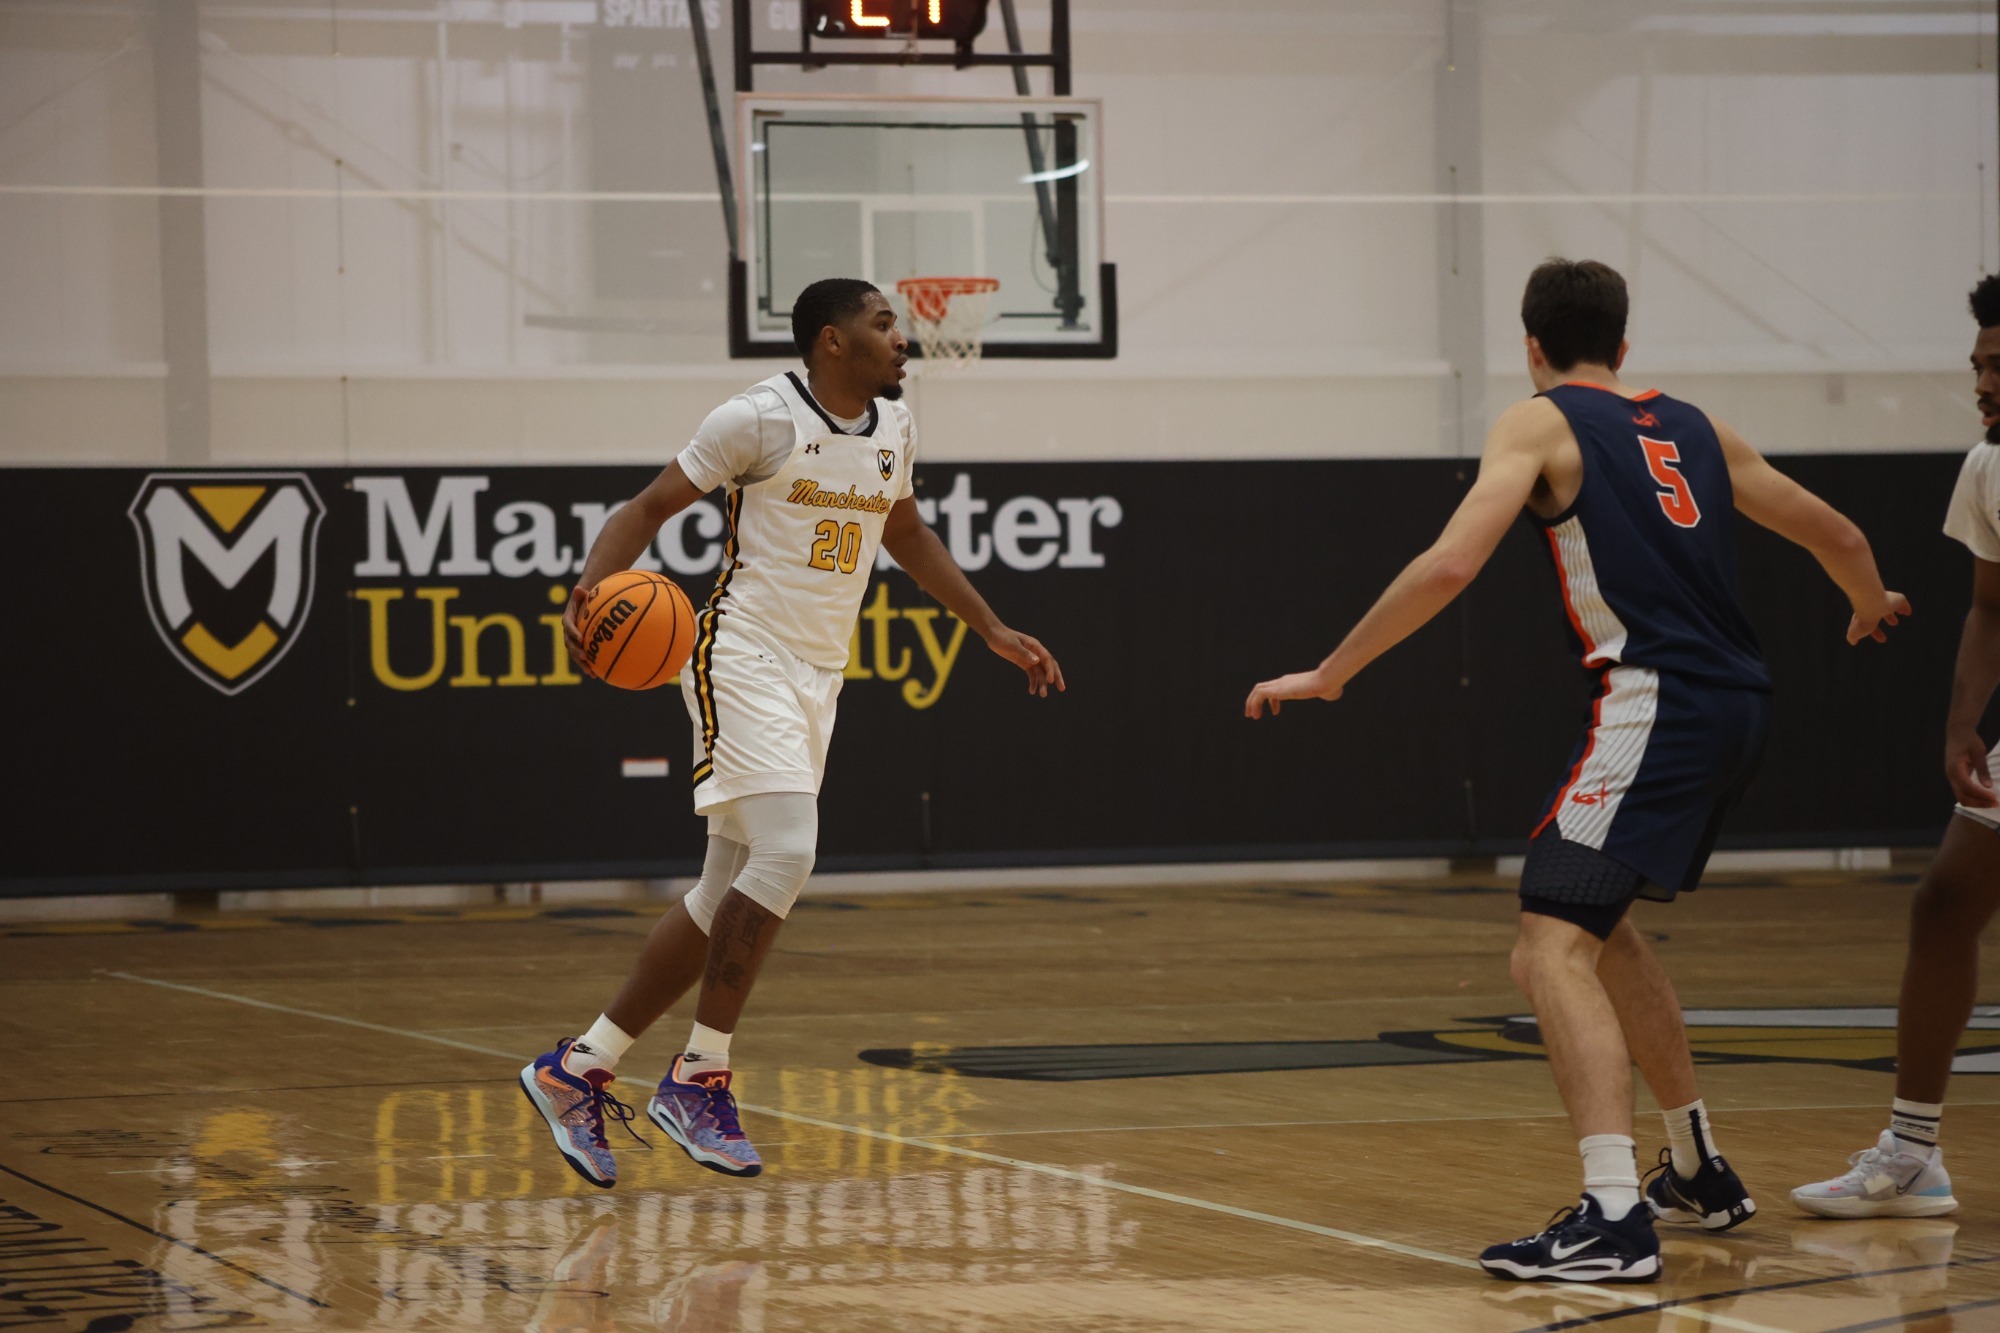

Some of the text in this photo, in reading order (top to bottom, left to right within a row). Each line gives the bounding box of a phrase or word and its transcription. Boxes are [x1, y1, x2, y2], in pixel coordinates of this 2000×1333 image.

[604, 0, 720, 28] SPARTAS
[1637, 434, 1701, 528] 5
[352, 473, 1123, 578] Macter
[808, 519, 862, 574] 20
[354, 582, 970, 709] Unity
[587, 599, 638, 664] Wilson
